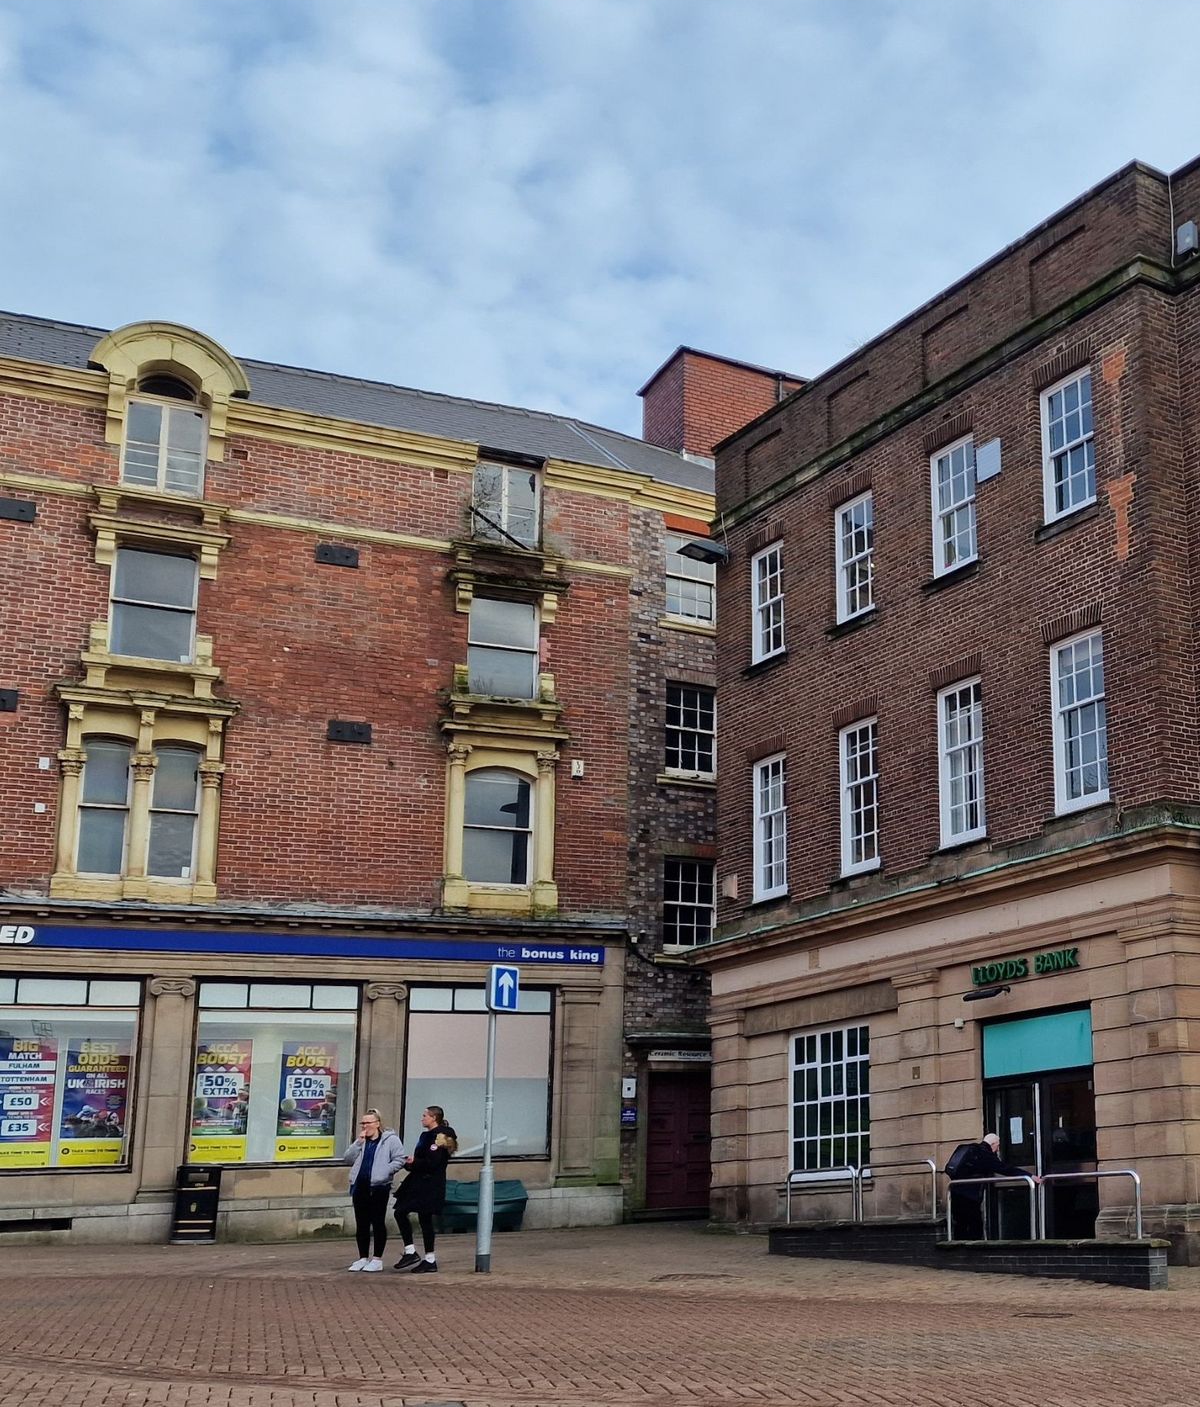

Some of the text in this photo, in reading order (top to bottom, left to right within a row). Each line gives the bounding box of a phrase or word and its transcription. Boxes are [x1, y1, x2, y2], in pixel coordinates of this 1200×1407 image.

[497, 946, 600, 963] the bonus king
[972, 947, 1079, 985] LLOYDS BANK
[14, 1041, 40, 1052] BIG
[81, 1042, 118, 1053] BEST
[208, 1043, 240, 1053] ACCA
[297, 1047, 326, 1055] ACCA
[8, 1052, 42, 1060] MATCH
[79, 1054, 119, 1065] ODDS
[197, 1053, 248, 1065] BOOST
[286, 1056, 333, 1067] BOOST
[67, 1079, 84, 1089] UK
[95, 1079, 126, 1089] IRISH
[204, 1075, 237, 1087] 50%
[293, 1077, 325, 1089] 50%
[202, 1087, 237, 1096] EXTRA
[291, 1090, 325, 1098] EXTRA
[10, 1097, 32, 1106] £50
[8, 1123, 29, 1132] £35
